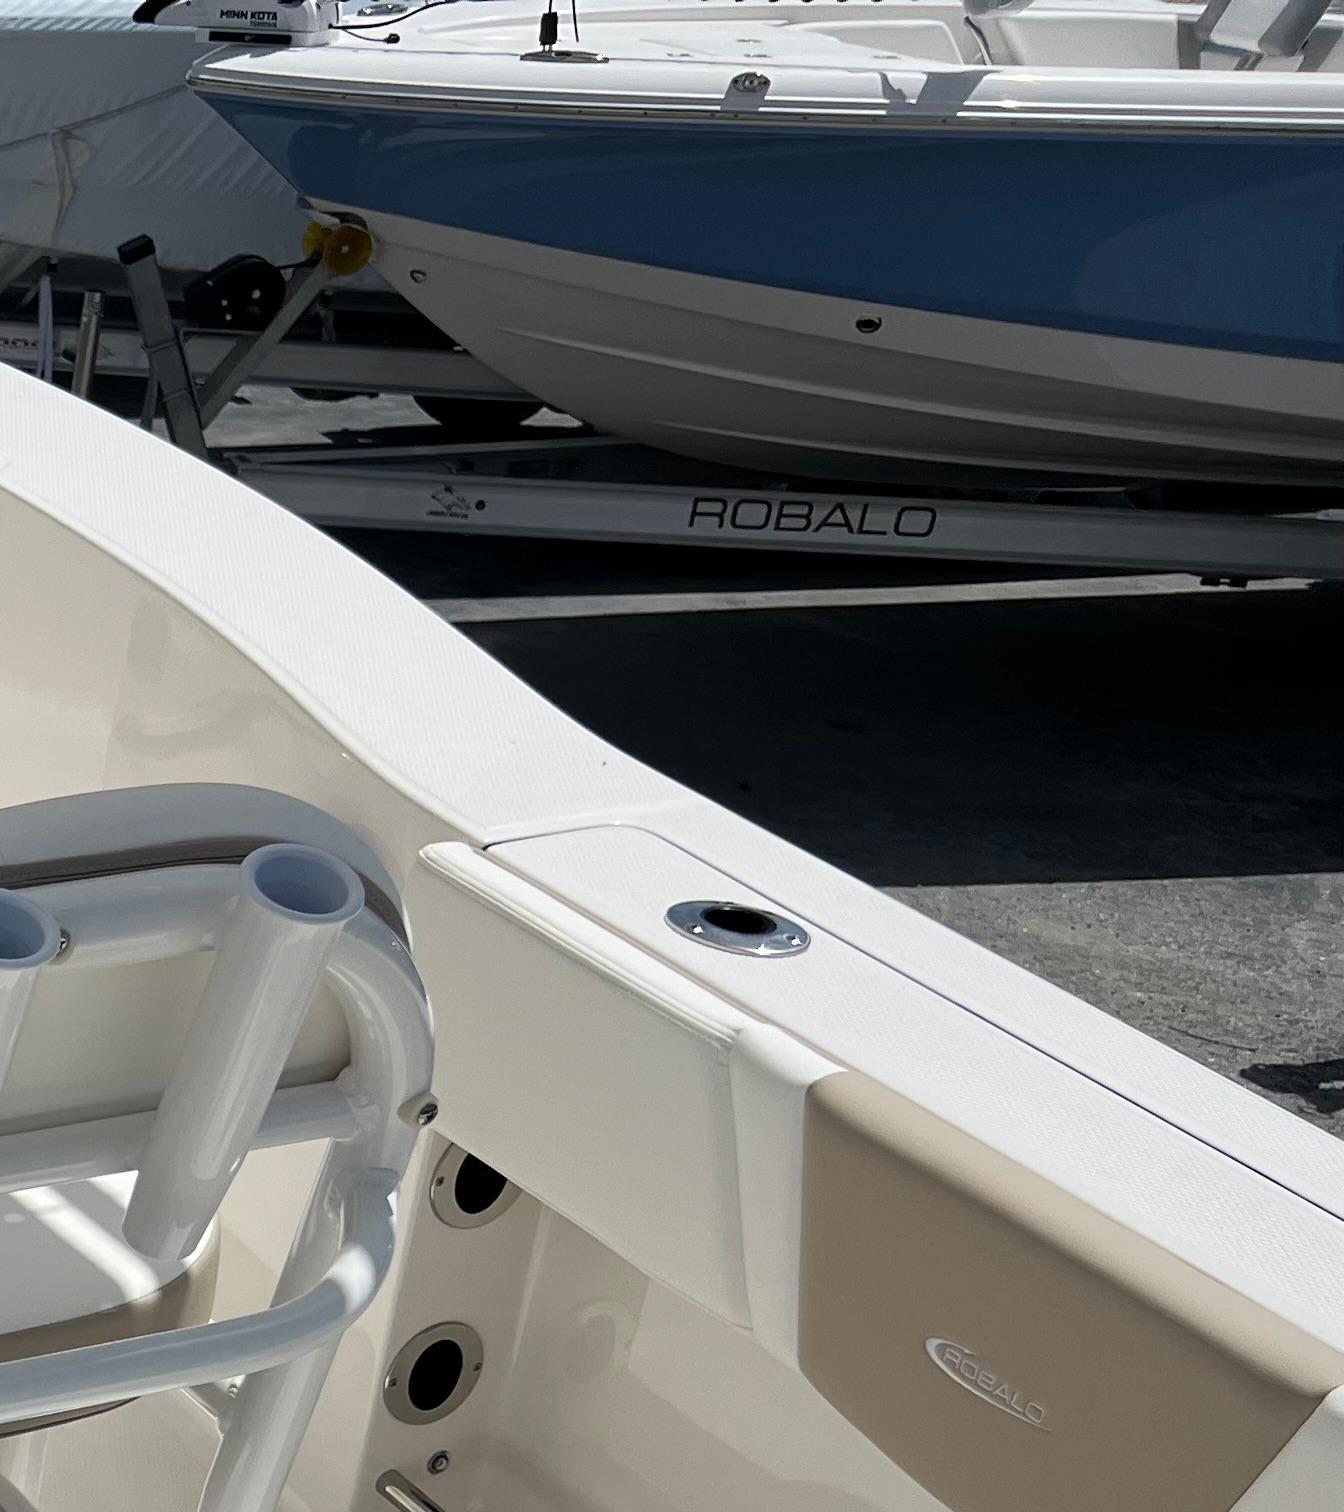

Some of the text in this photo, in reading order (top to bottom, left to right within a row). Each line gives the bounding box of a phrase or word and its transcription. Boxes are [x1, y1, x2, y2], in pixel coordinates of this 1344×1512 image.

[220, 9, 278, 21] MINN KOTA
[687, 497, 937, 538] ROBALO
[943, 1348, 1045, 1424] ROBALO
